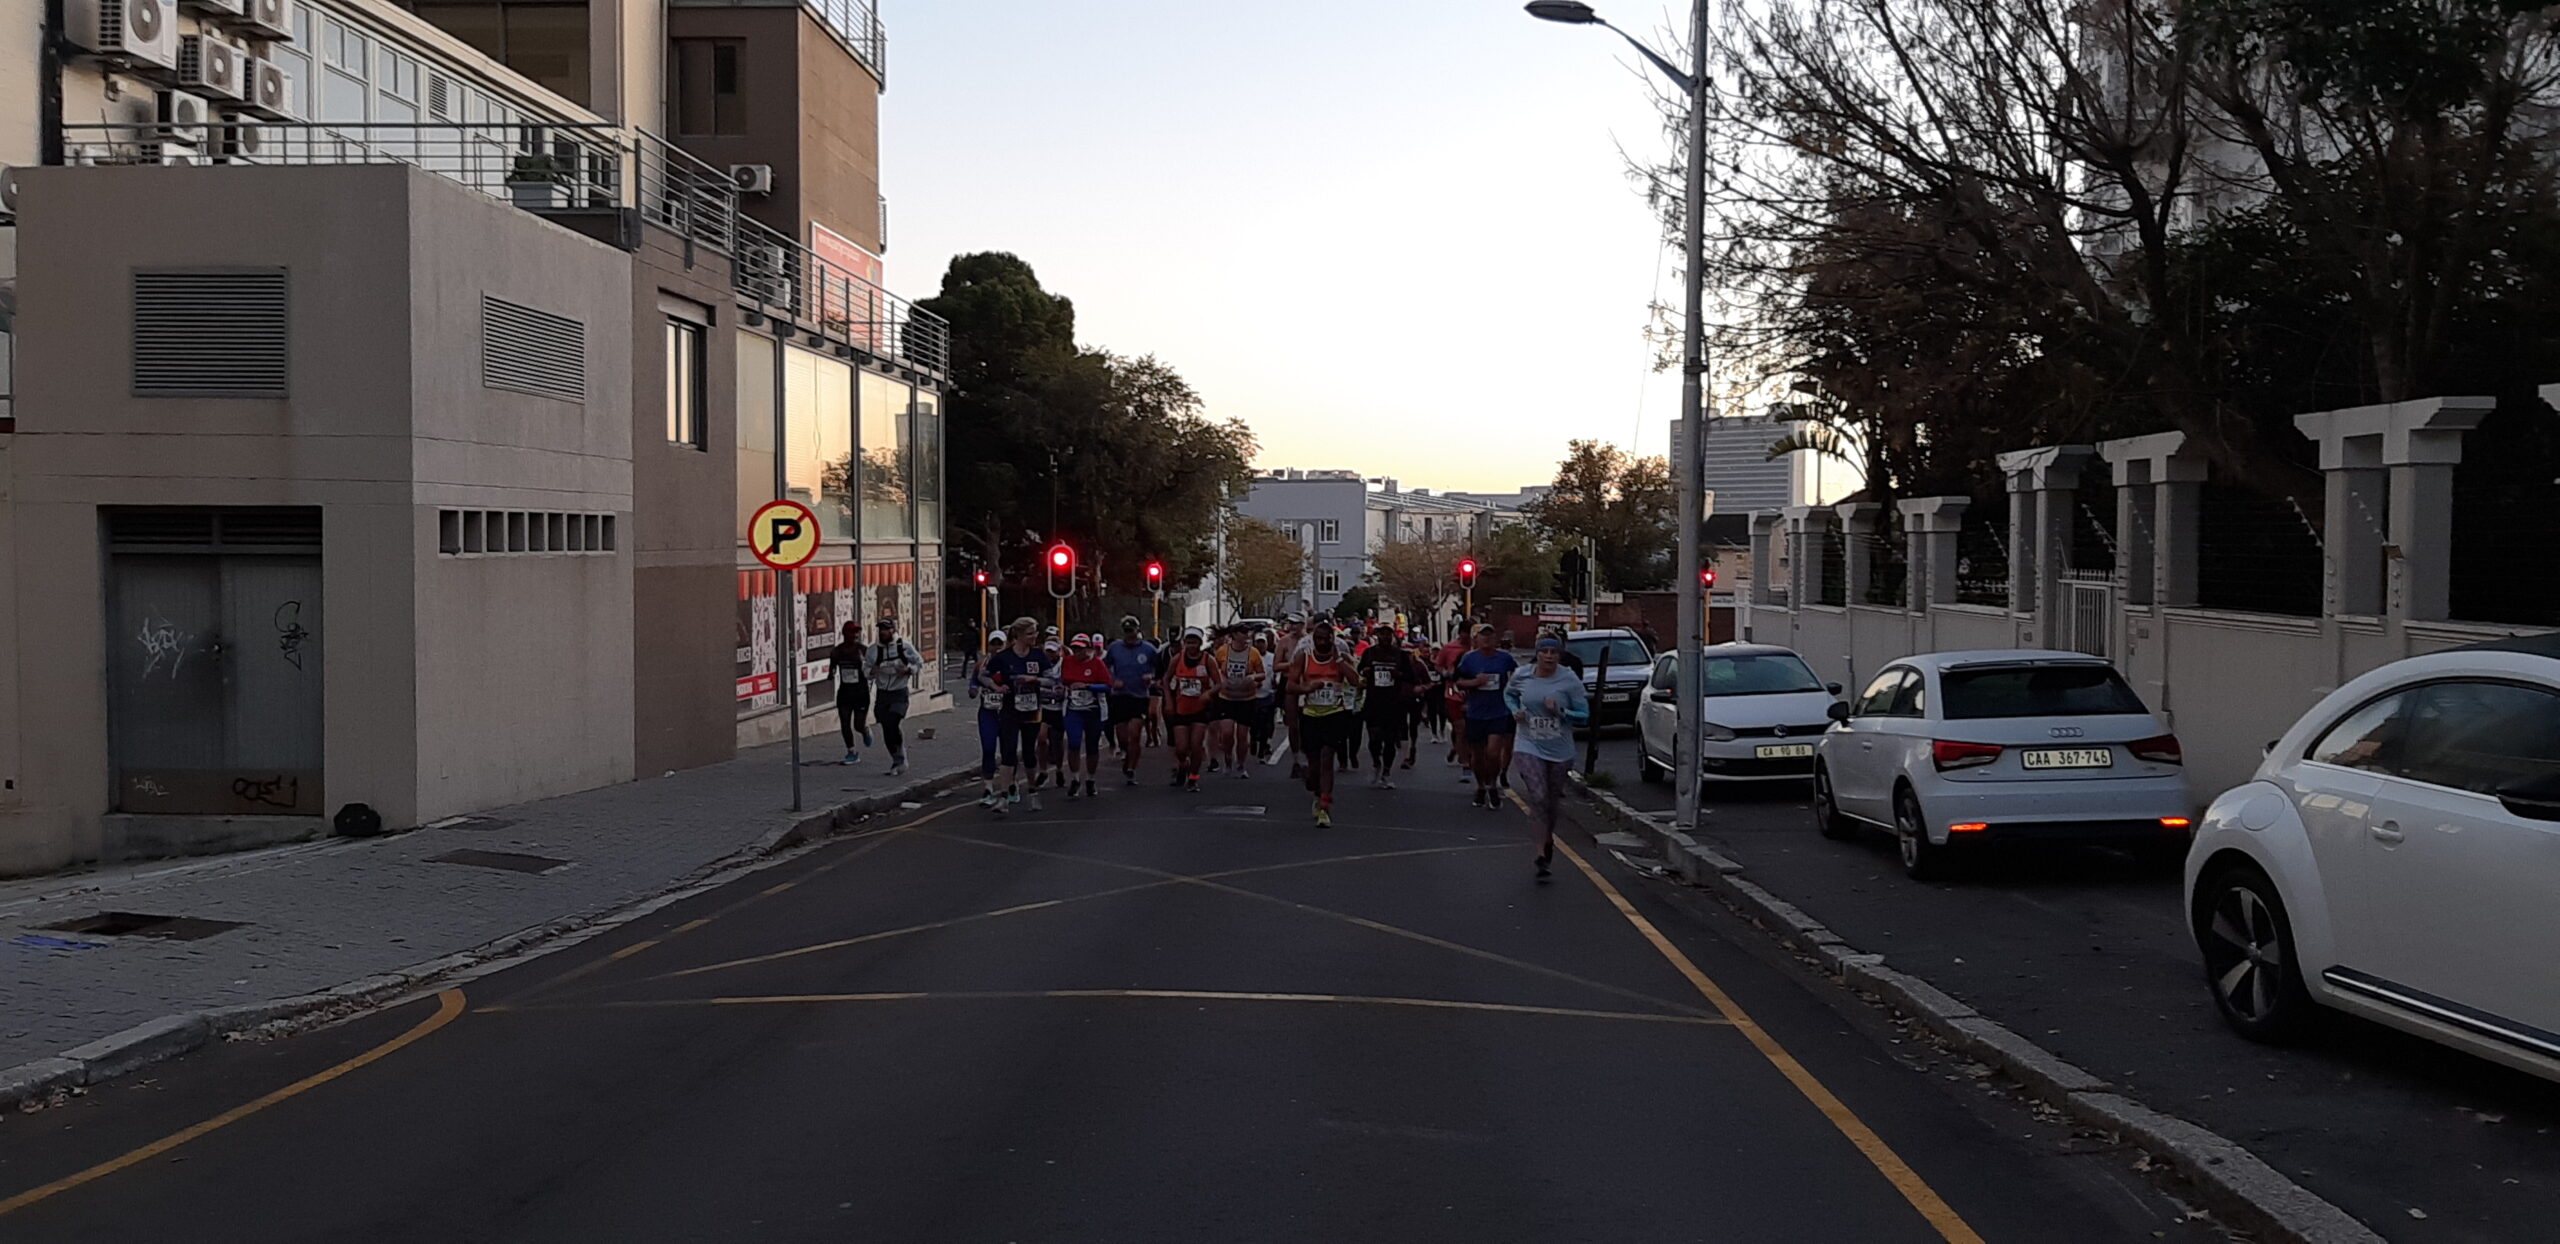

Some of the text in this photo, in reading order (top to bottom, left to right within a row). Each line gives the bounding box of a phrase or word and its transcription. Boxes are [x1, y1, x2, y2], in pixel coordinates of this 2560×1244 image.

[771, 517, 802, 554] P
[1763, 748, 1773, 756] CA
[1780, 746, 1791, 755] 90
[2027, 750, 2108, 766] CAA 367-746
